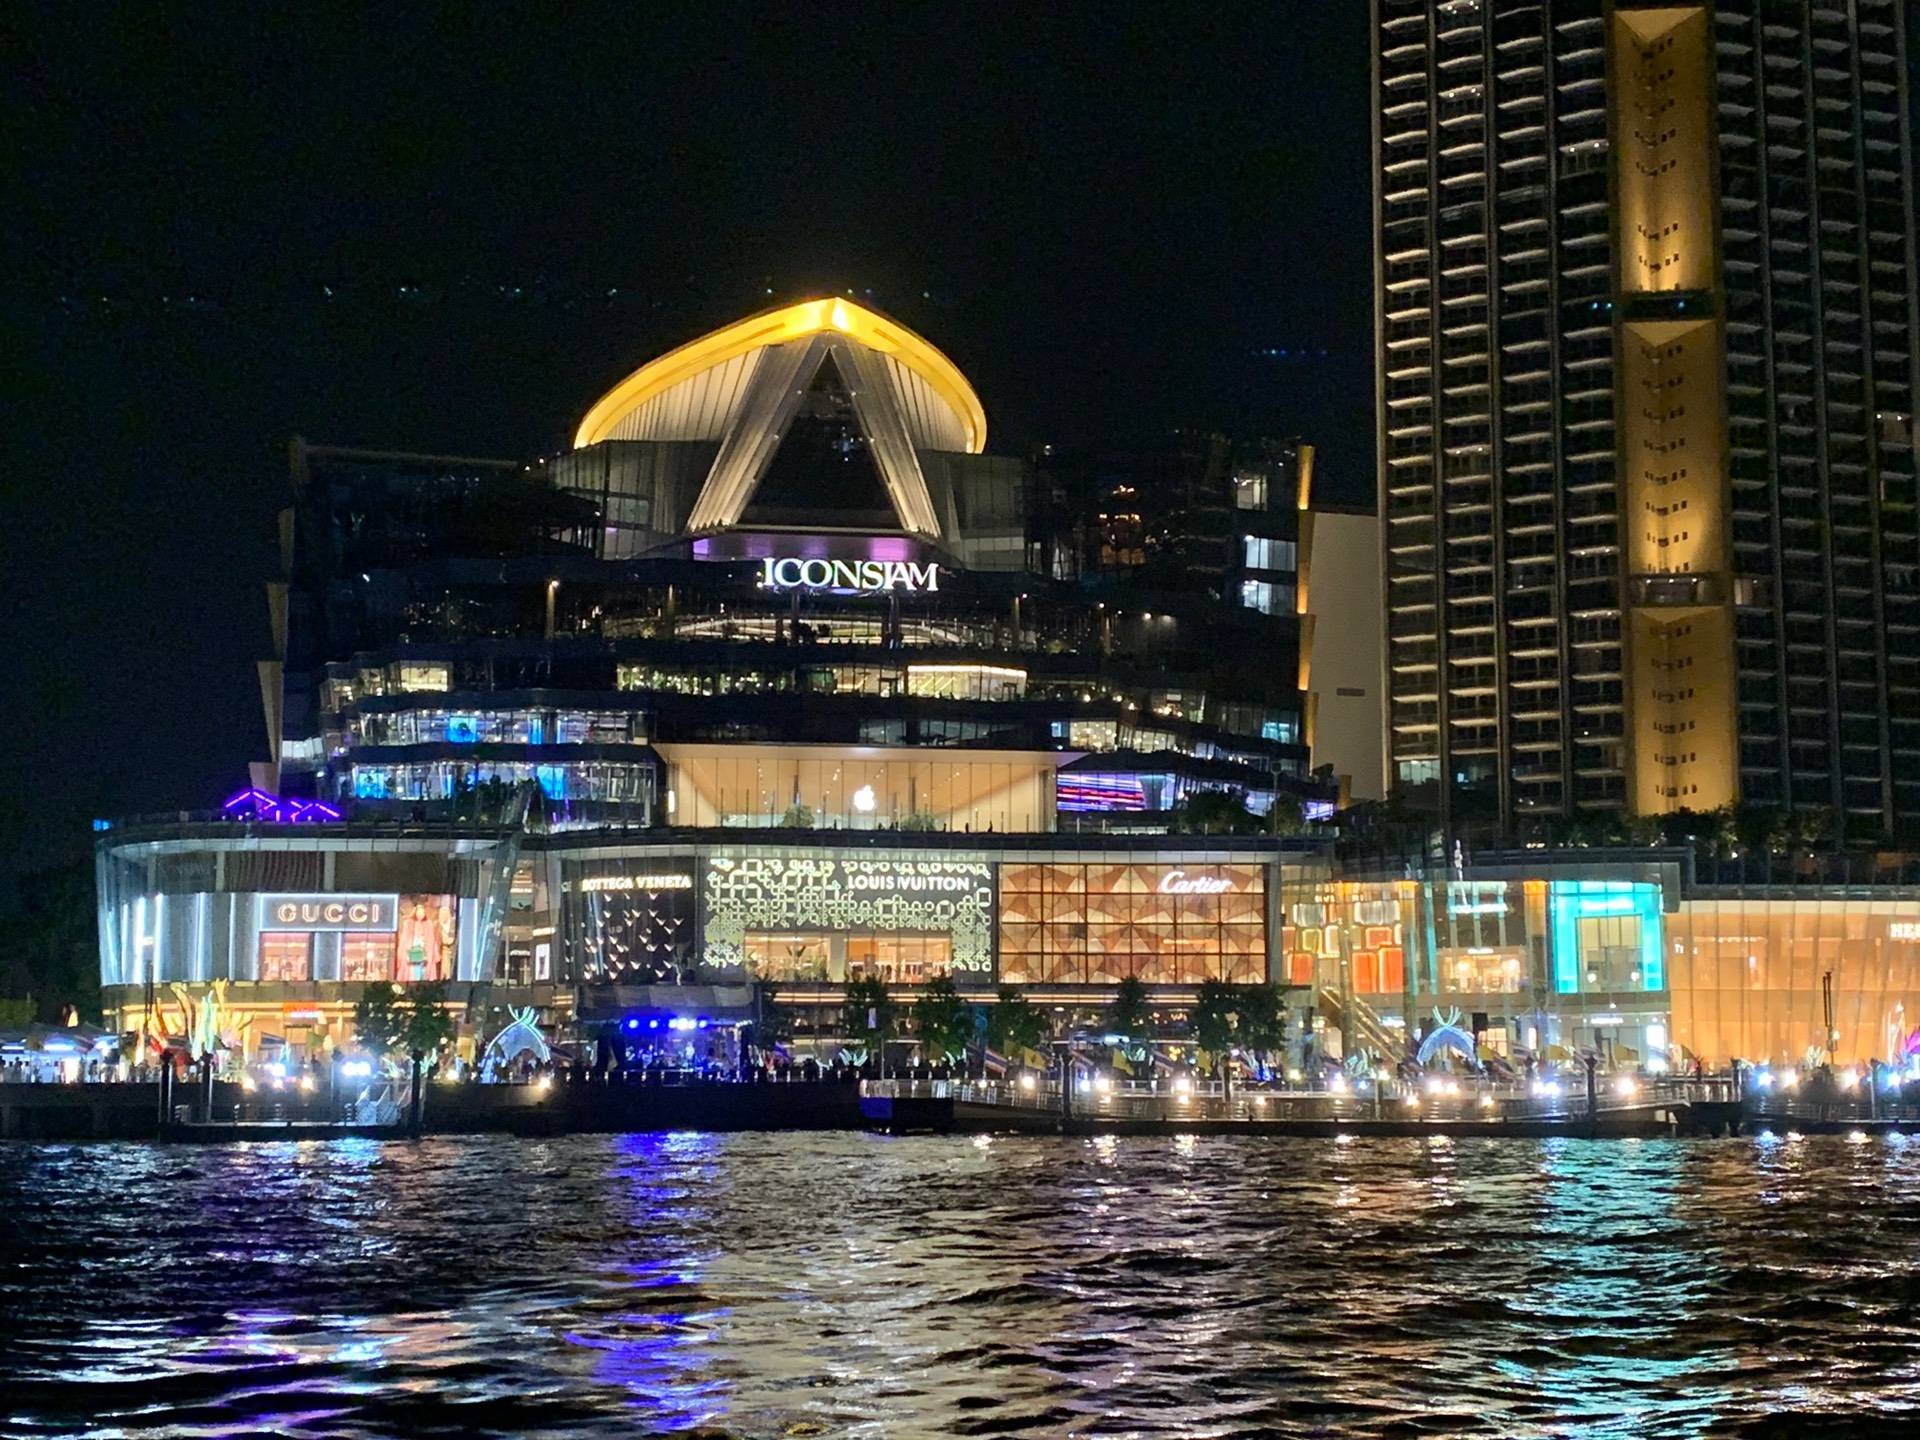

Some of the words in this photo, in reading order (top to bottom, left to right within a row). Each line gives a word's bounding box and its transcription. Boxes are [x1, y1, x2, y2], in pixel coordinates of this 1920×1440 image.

[763, 557, 939, 591] ICONSIAM
[581, 877, 634, 891] BOTTEGA
[635, 875, 692, 889] VENETA
[848, 875, 894, 890] LOUIS
[898, 875, 969, 891] VUITTON
[1160, 870, 1232, 894] Cartier
[277, 903, 380, 923] GUCCI
